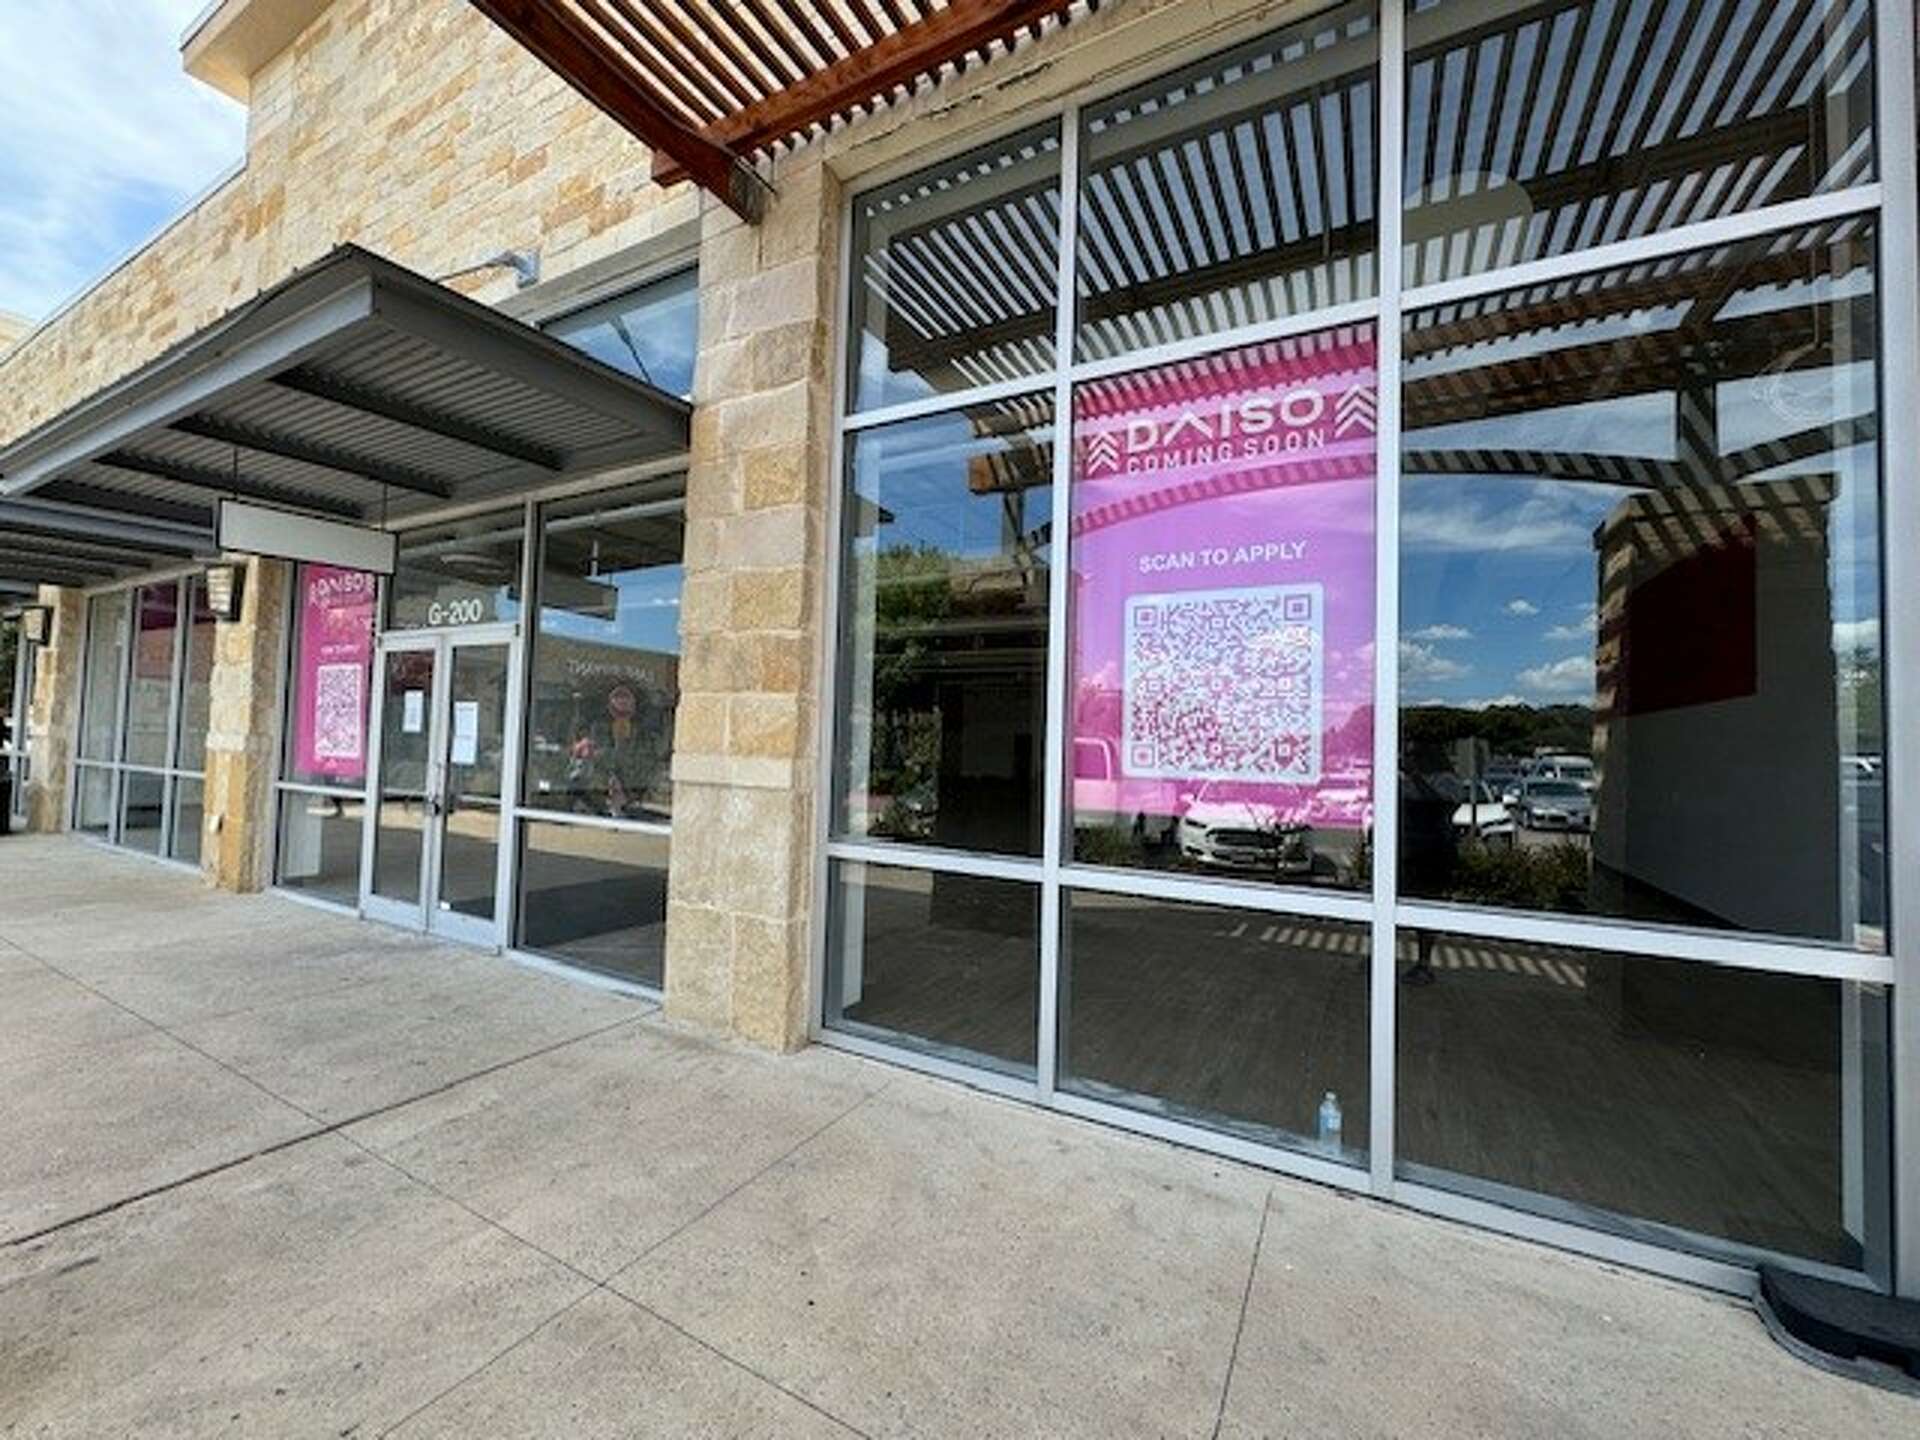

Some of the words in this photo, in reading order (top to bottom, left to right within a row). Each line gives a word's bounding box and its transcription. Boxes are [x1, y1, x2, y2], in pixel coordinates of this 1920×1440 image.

[1126, 388, 1324, 454] DAISO
[1127, 441, 1233, 474] COMING
[1243, 428, 1325, 460] SOON
[1138, 551, 1195, 574] SCAN
[1200, 548, 1229, 566] TO
[1232, 539, 1308, 563] APPLY
[428, 598, 484, 625] G-200
